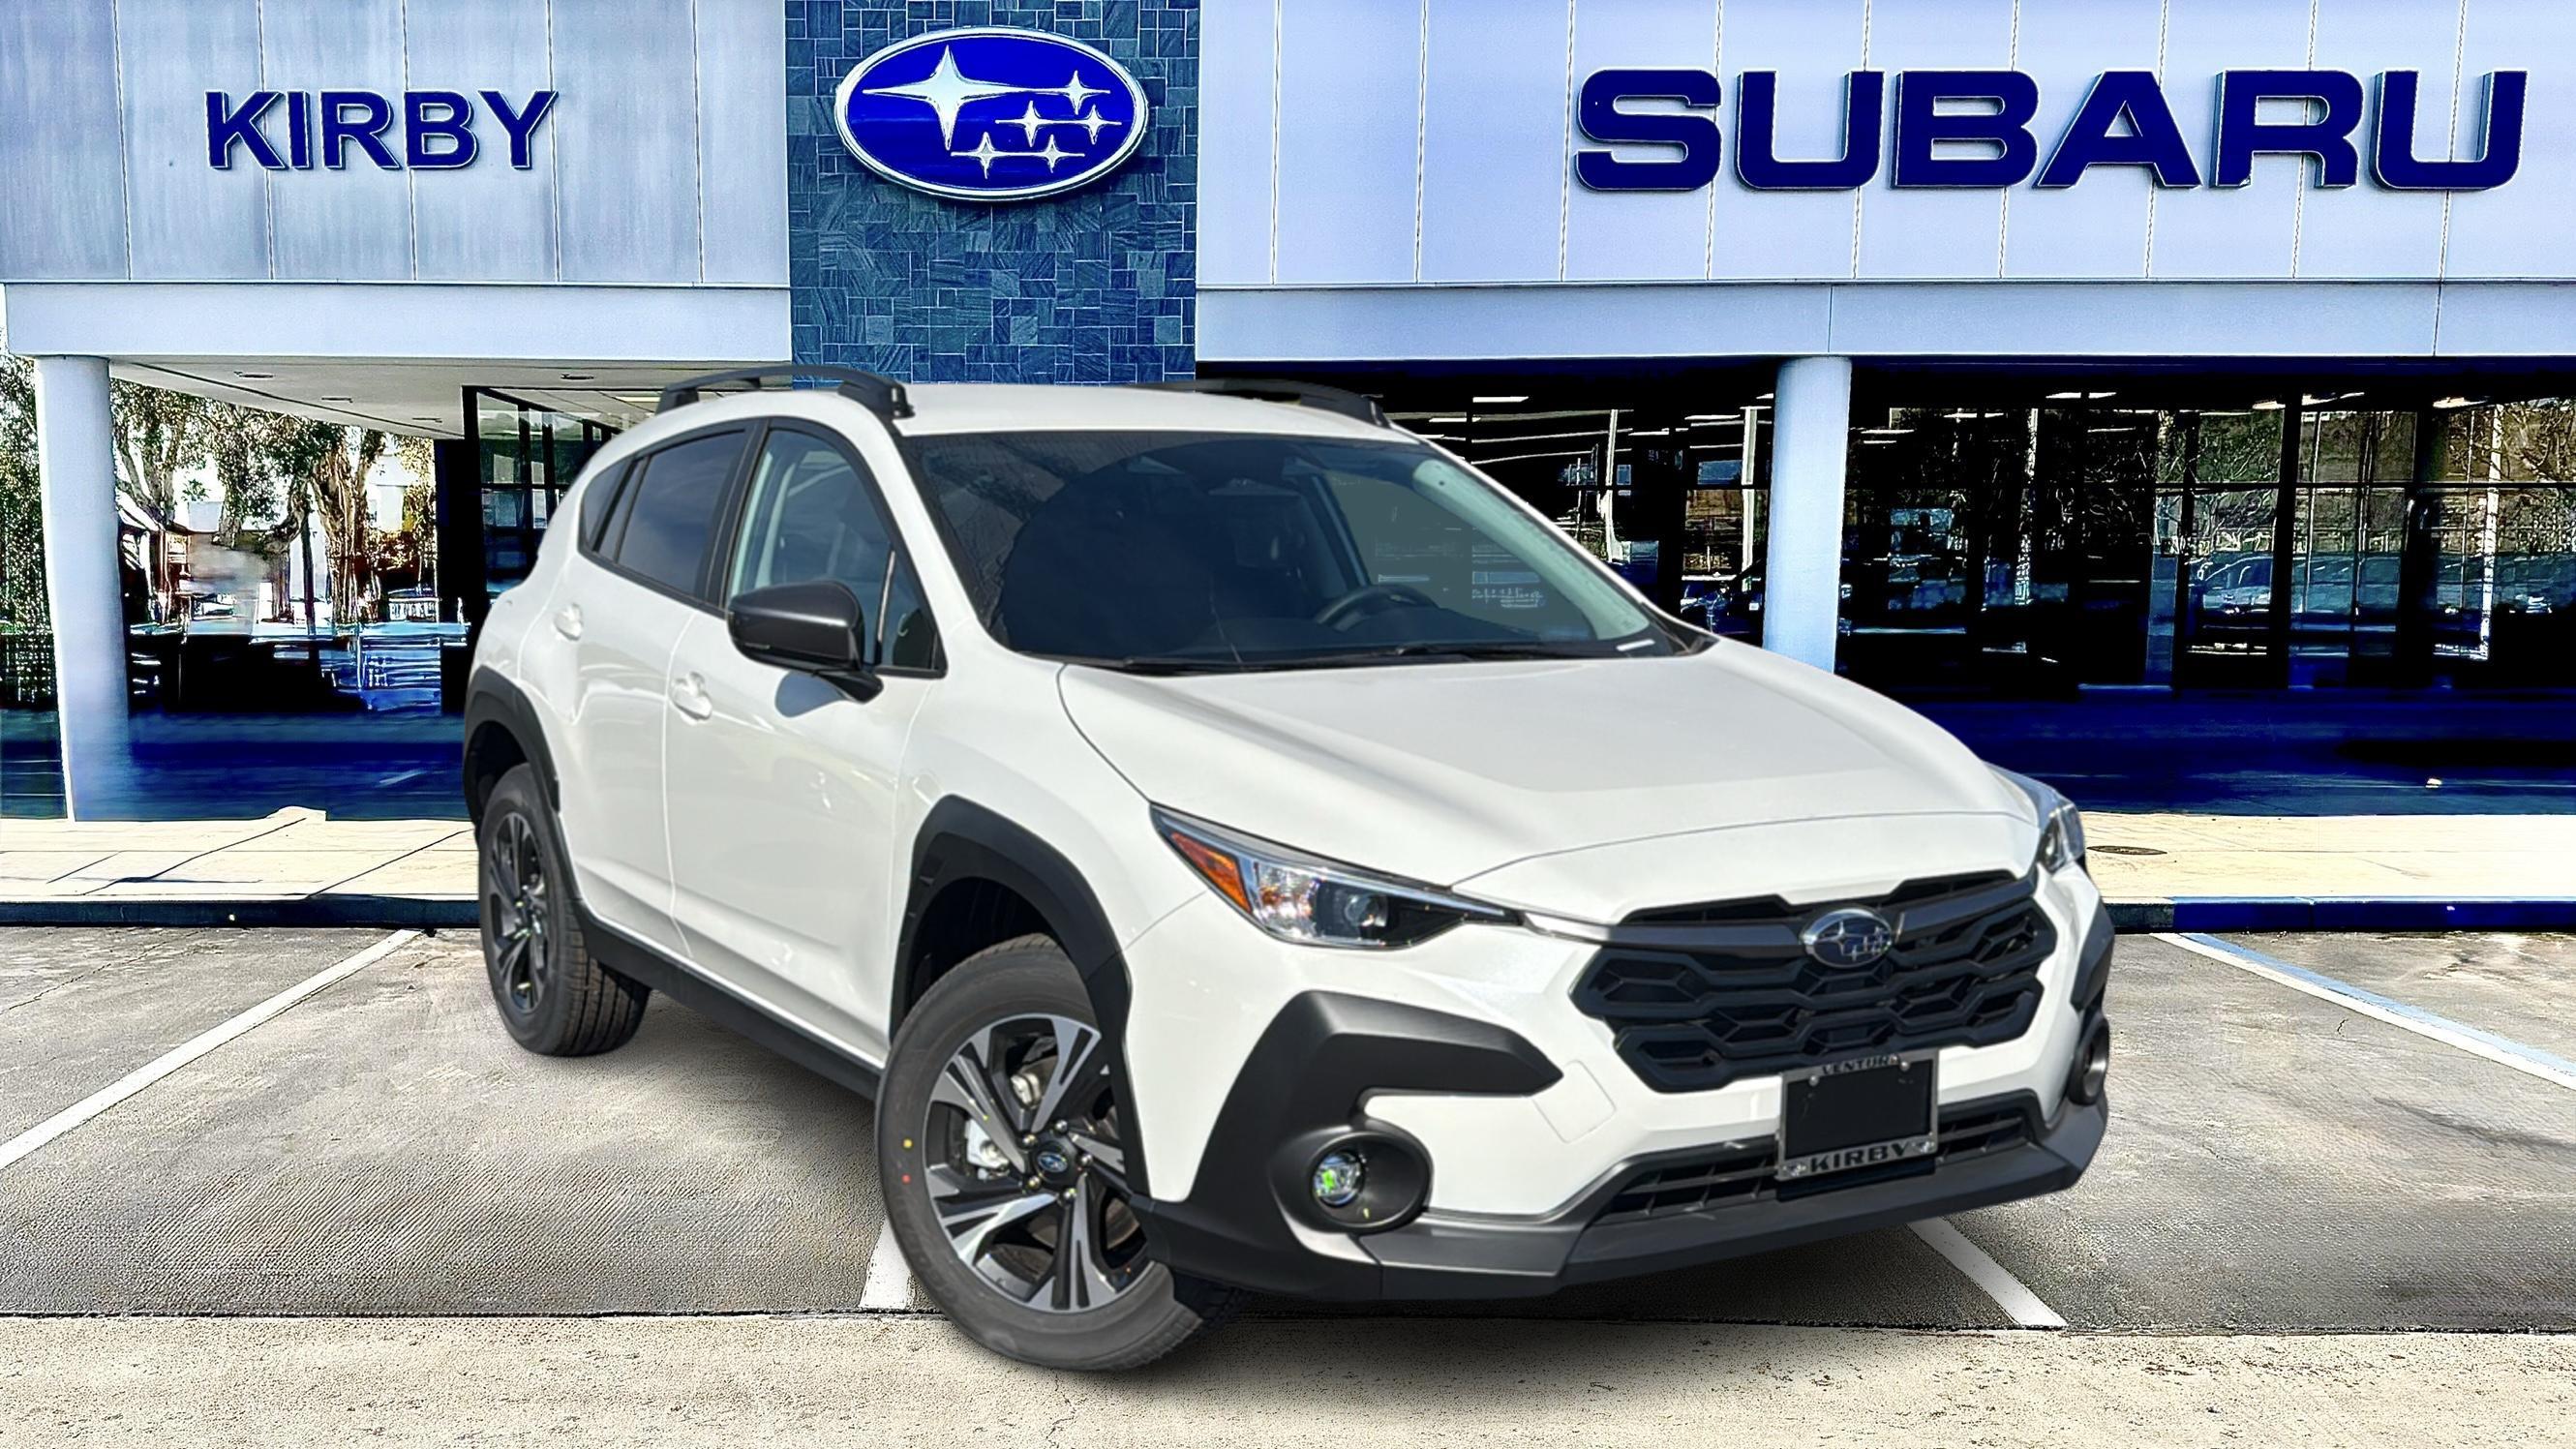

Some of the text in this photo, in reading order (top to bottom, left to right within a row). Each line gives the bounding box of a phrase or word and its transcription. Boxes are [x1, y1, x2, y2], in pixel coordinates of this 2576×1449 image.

[204, 90, 559, 169] KIRBY
[1576, 69, 2528, 191] SUBARU
[1821, 1054, 1898, 1074] VENTUR
[1809, 1140, 1909, 1173] KIRBY
